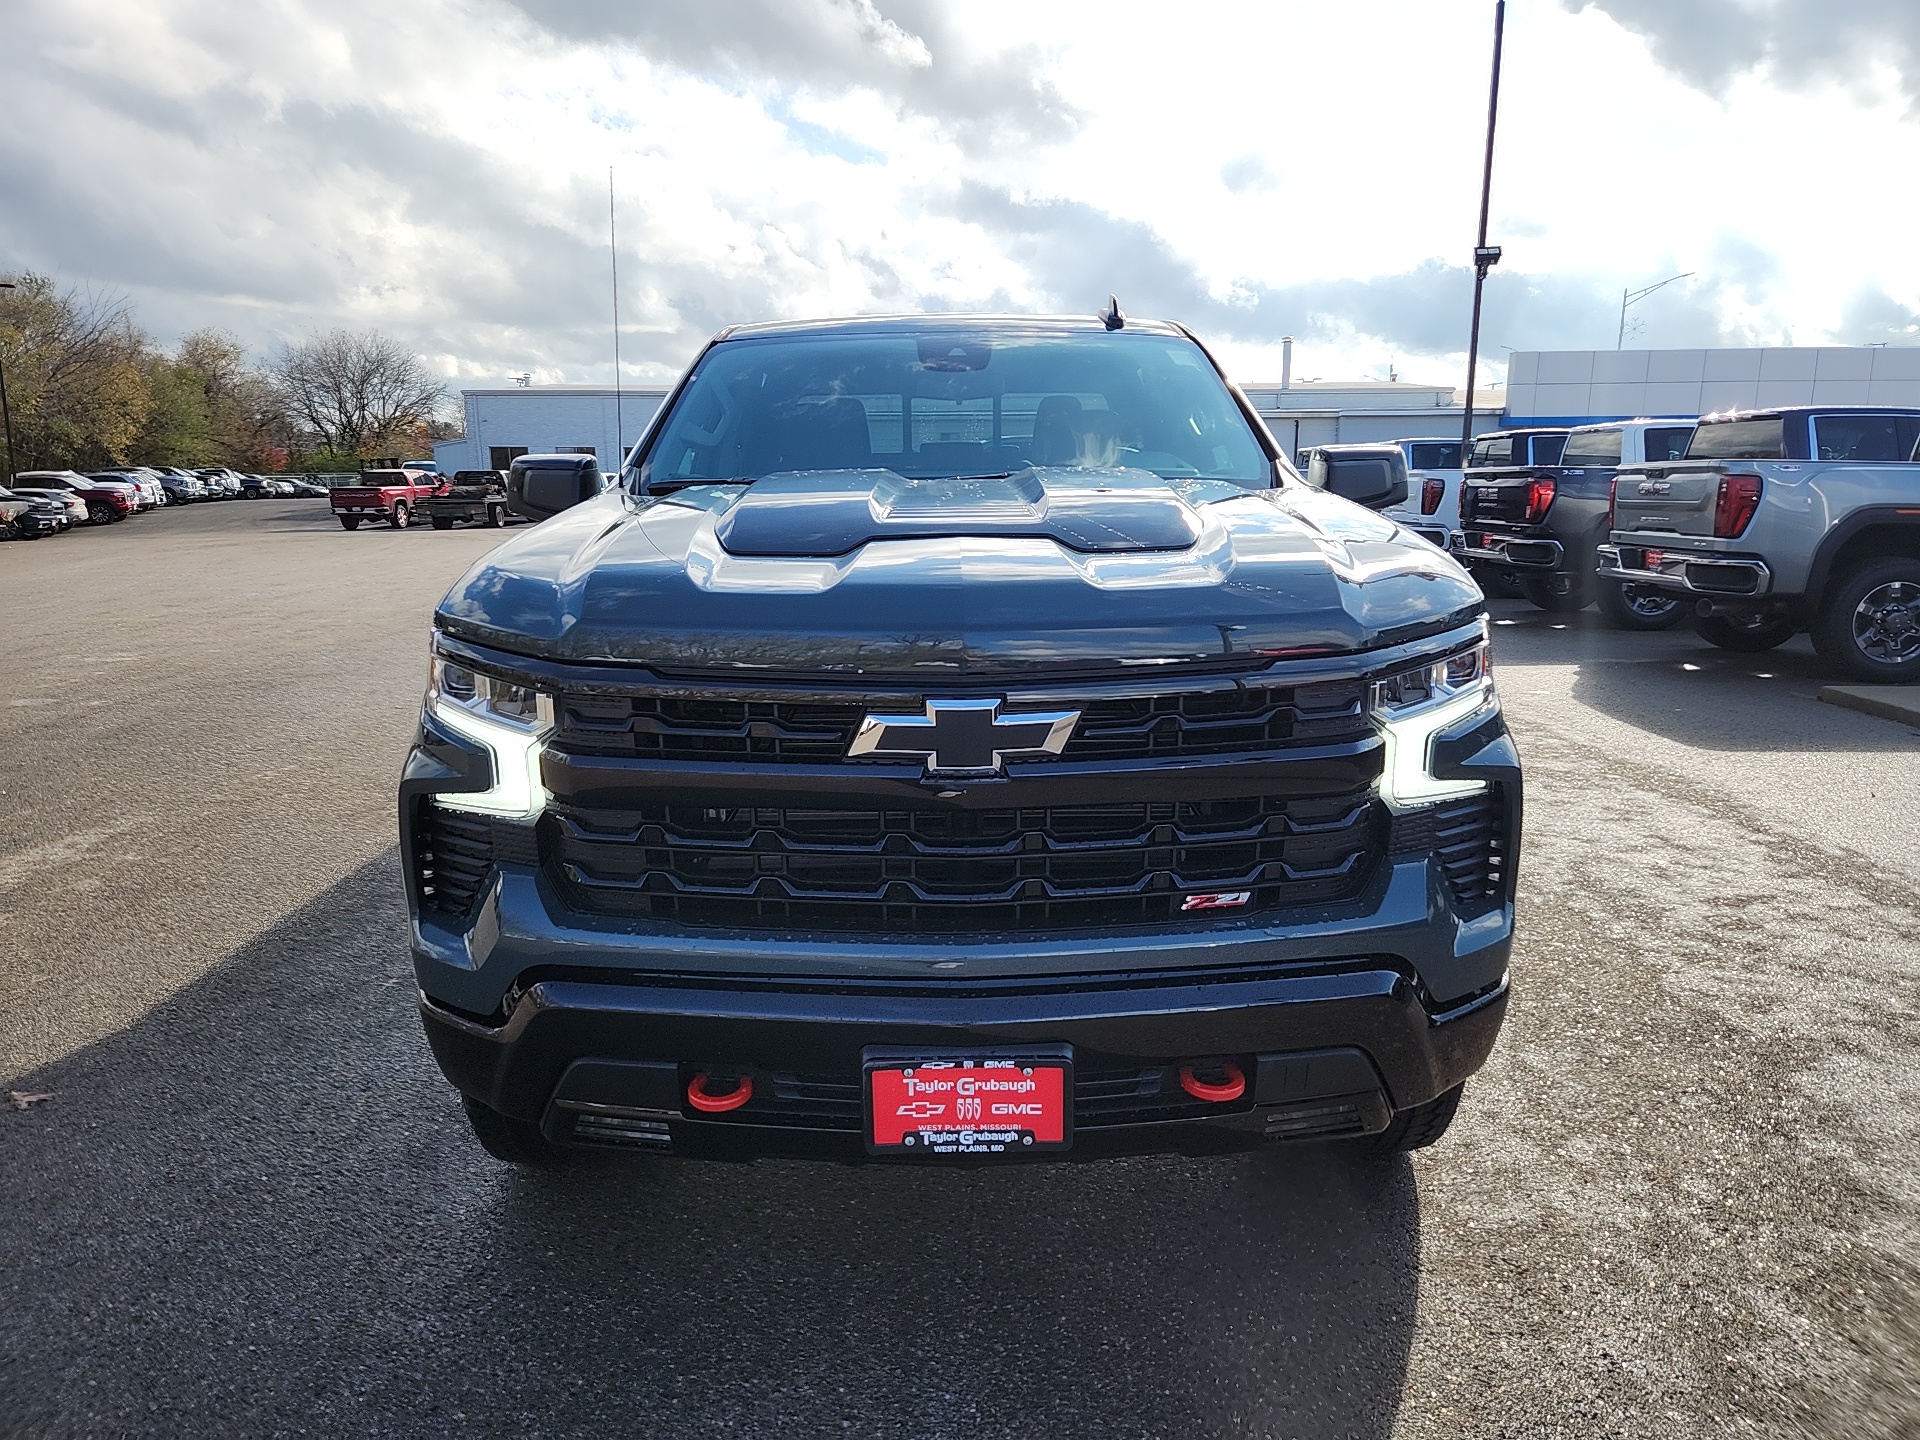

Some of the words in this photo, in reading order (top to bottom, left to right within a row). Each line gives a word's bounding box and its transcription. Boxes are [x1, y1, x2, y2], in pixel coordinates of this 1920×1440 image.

[1181, 891, 1251, 911] Z71
[984, 1060, 1016, 1069] GMC
[902, 1078, 955, 1097] Taylor
[956, 1077, 1036, 1097] Grubaugh
[991, 1103, 1043, 1115] GMC
[980, 1123, 1022, 1131] MISSOURI
[919, 1131, 959, 1146] Taylor
[958, 1130, 1019, 1145] Grubaugh
[933, 1145, 957, 1153] WEST
[990, 1144, 1005, 1152] MO
